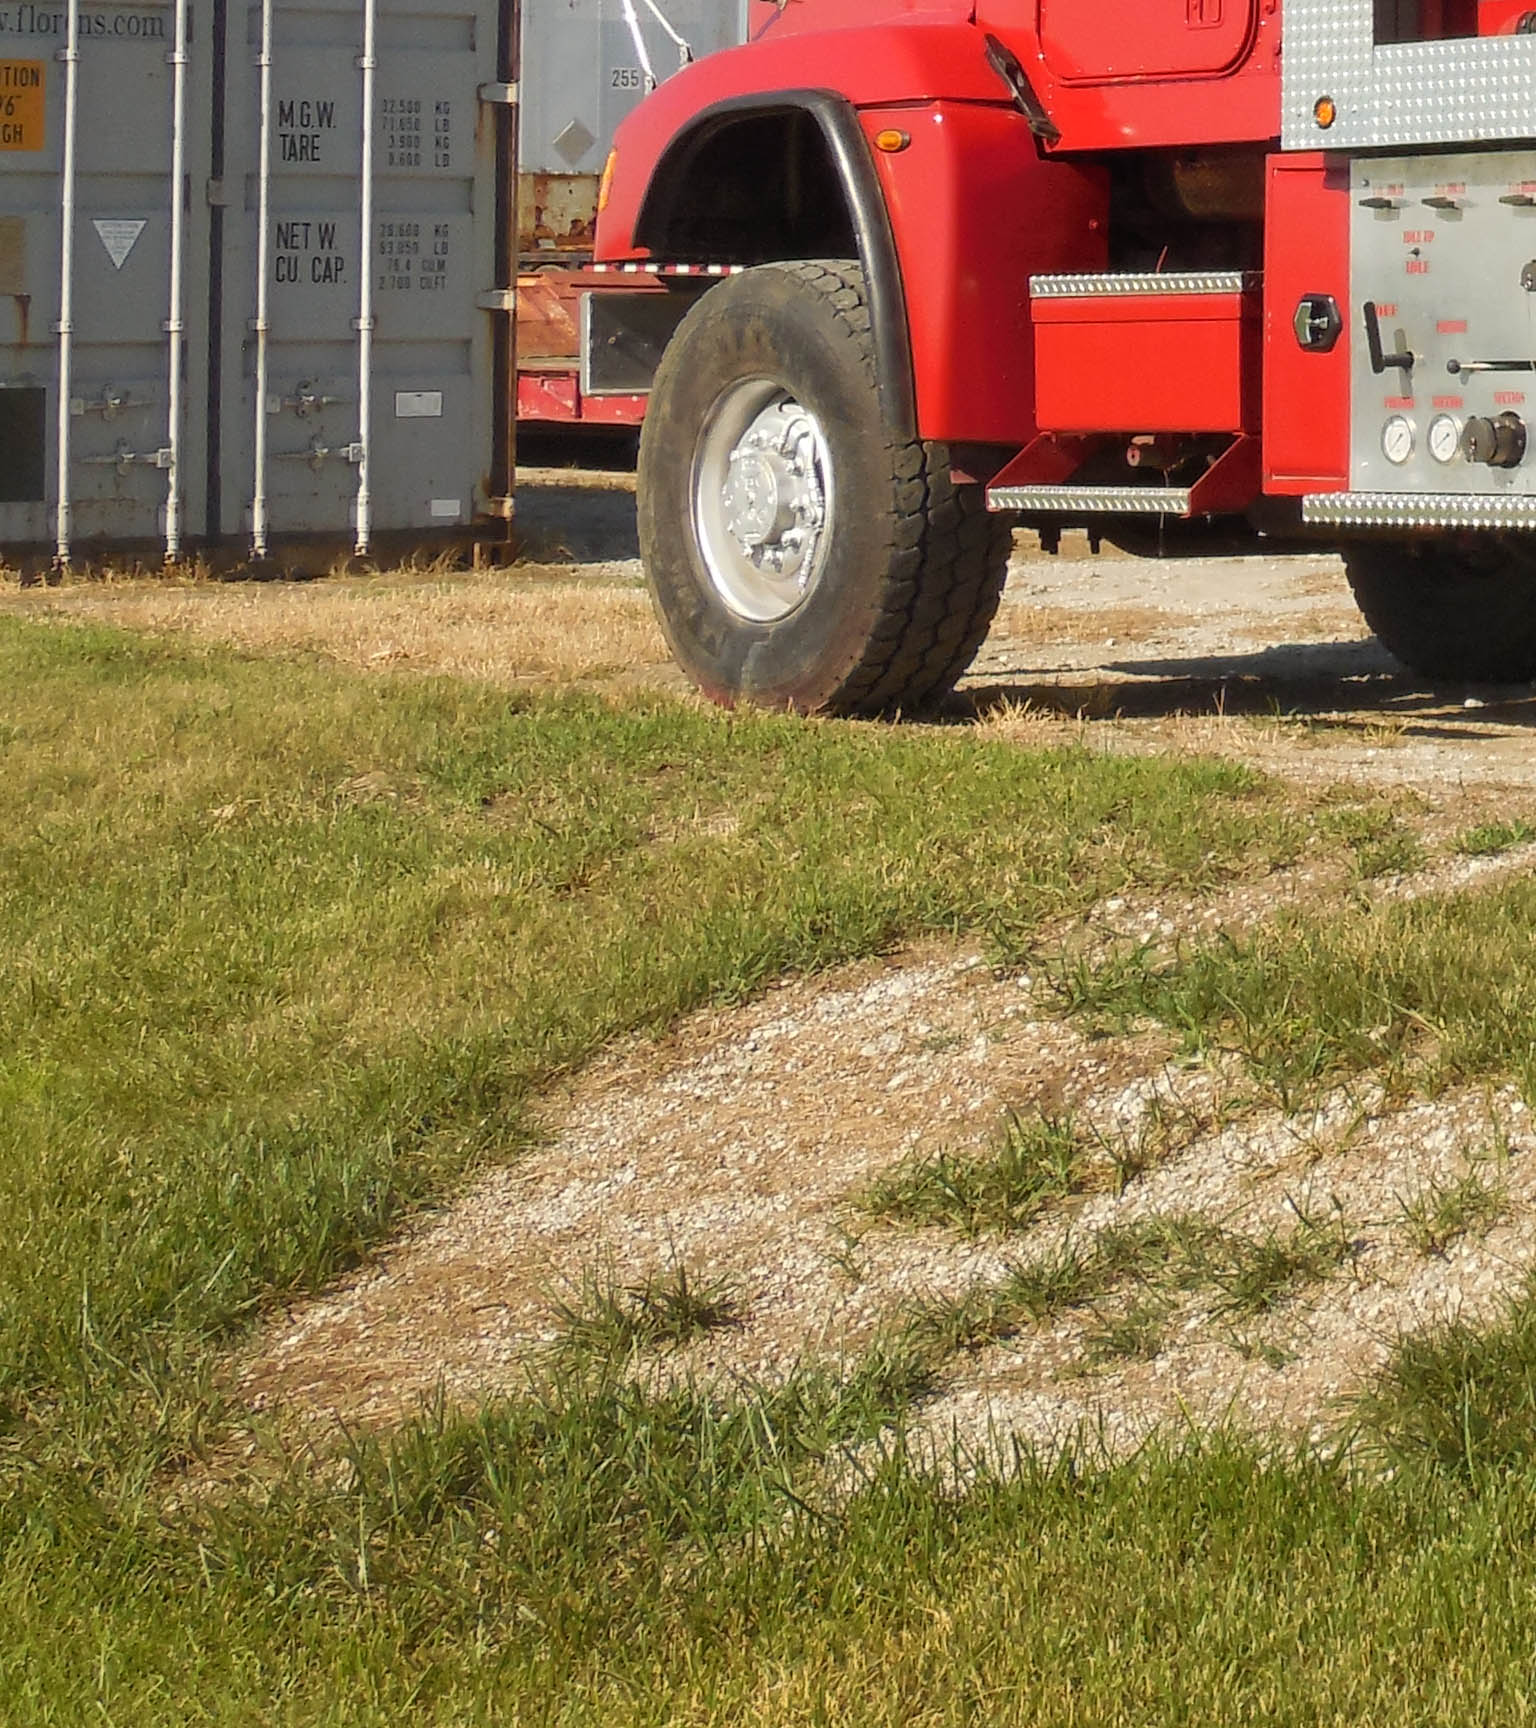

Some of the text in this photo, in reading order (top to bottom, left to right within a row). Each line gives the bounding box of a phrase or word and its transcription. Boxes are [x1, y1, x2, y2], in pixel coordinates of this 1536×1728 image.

[612, 69, 640, 87] 255
[279, 100, 336, 129] M.G.W.
[279, 134, 321, 162] TARE
[276, 223, 311, 250] NET
[311, 257, 347, 285] CAP.
